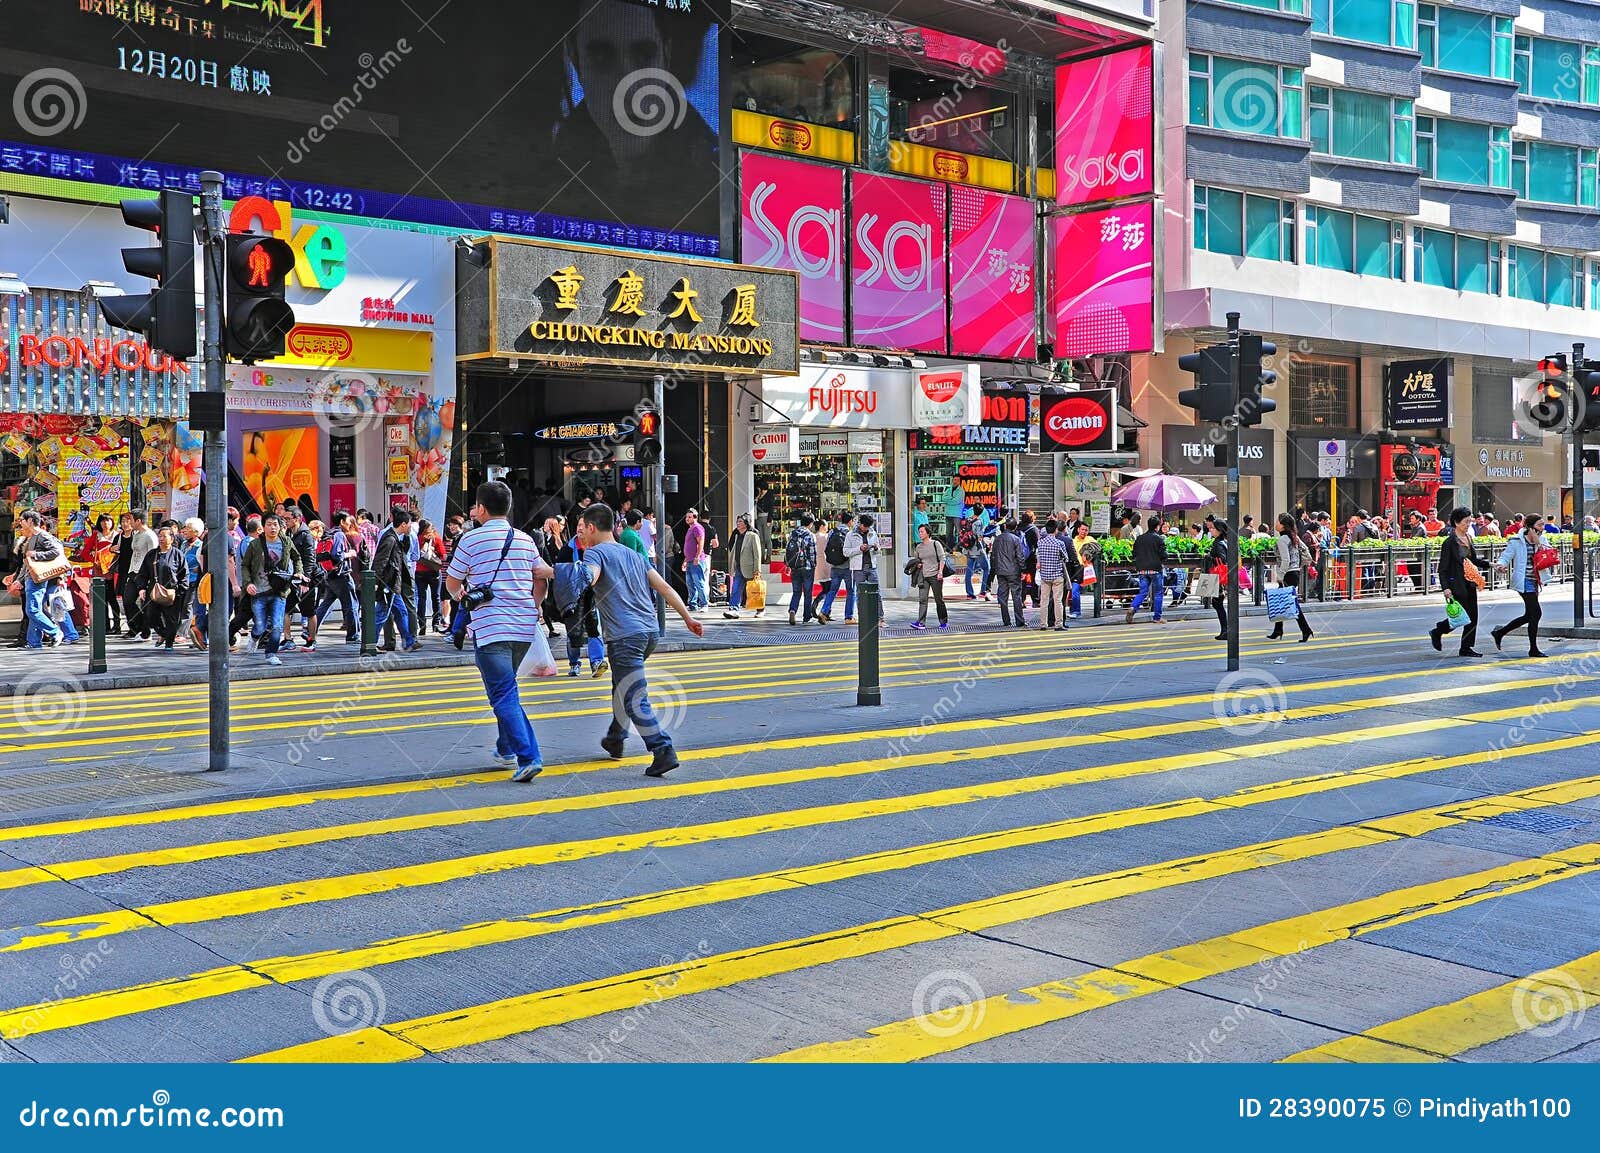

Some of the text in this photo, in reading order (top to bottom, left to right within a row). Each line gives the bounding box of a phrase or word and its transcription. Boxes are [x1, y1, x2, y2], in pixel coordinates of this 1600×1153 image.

[117, 47, 218, 88] 12月20日
[1100, 217, 1145, 251] 莎莎
[987, 248, 1031, 295] 莎莎
[363, 310, 435, 325] SHOPPING MALL
[530, 321, 773, 357] CHUNGKING MANSIONS
[260, 398, 313, 408] CHRISTMAS
[808, 387, 877, 419] FUJITSU
[1049, 414, 1102, 431] Canon
[752, 433, 788, 445] Canon
[962, 426, 989, 443] TAX
[990, 427, 1026, 445] FREE
[1182, 443, 1201, 457] THE
[64, 456, 105, 475] Happy
[958, 465, 998, 477] Canon
[1487, 465, 1532, 478] IMPERIAL HOTEL
[95, 472, 123, 490] Year
[961, 479, 997, 492] Nikon
[80, 486, 123, 501] 2013
